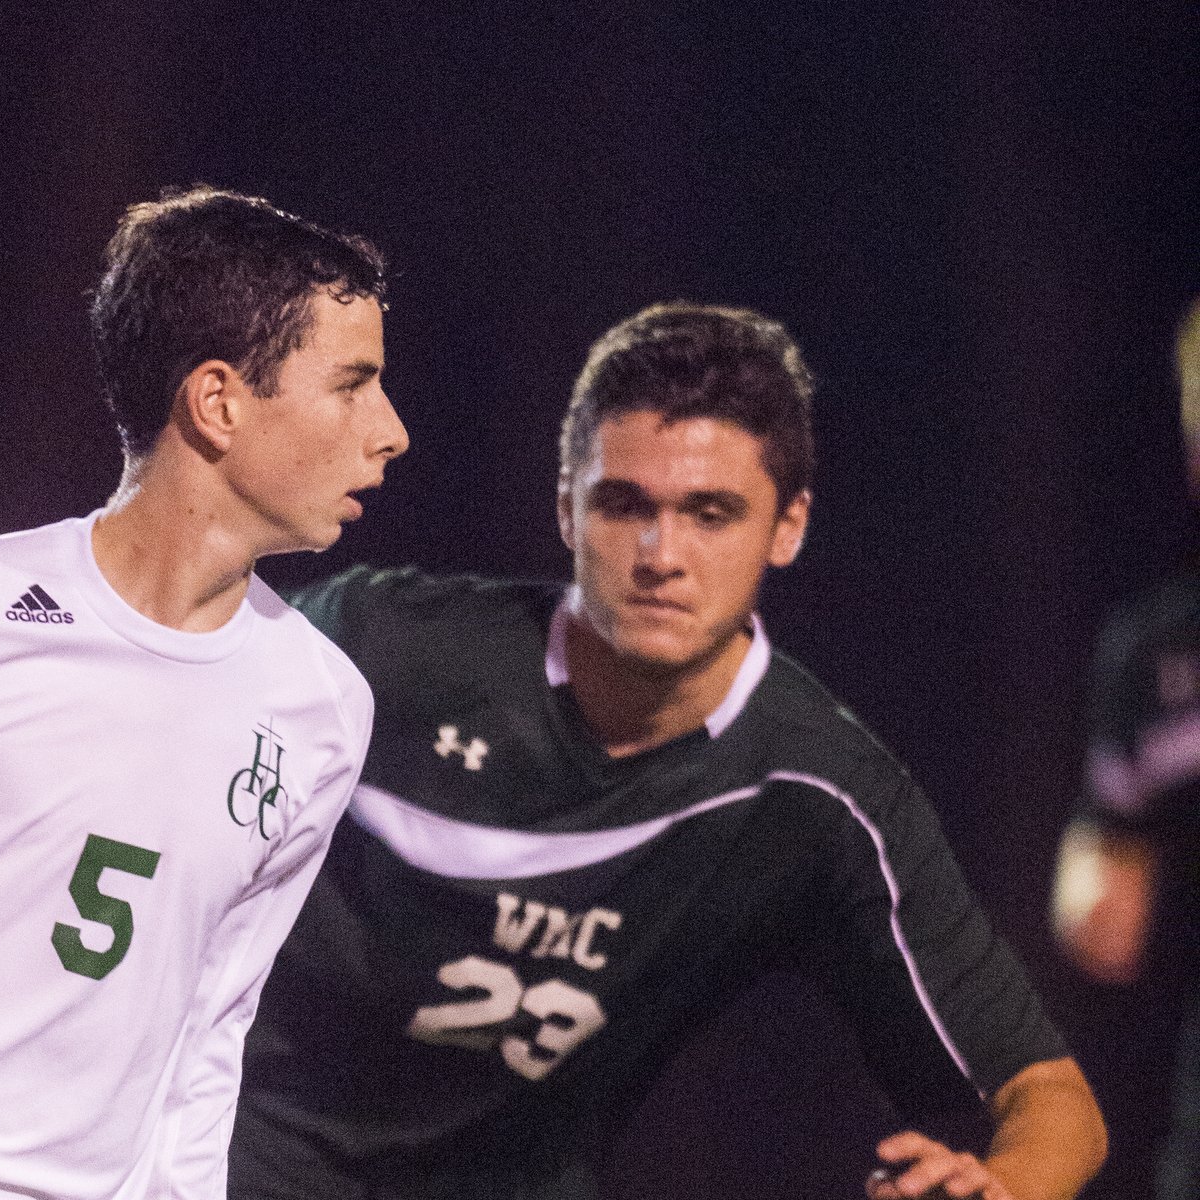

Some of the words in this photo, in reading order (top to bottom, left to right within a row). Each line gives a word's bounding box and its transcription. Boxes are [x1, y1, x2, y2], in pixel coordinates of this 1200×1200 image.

[5, 607, 75, 625] adidas
[51, 832, 162, 981] 5
[407, 954, 608, 1082] 23
